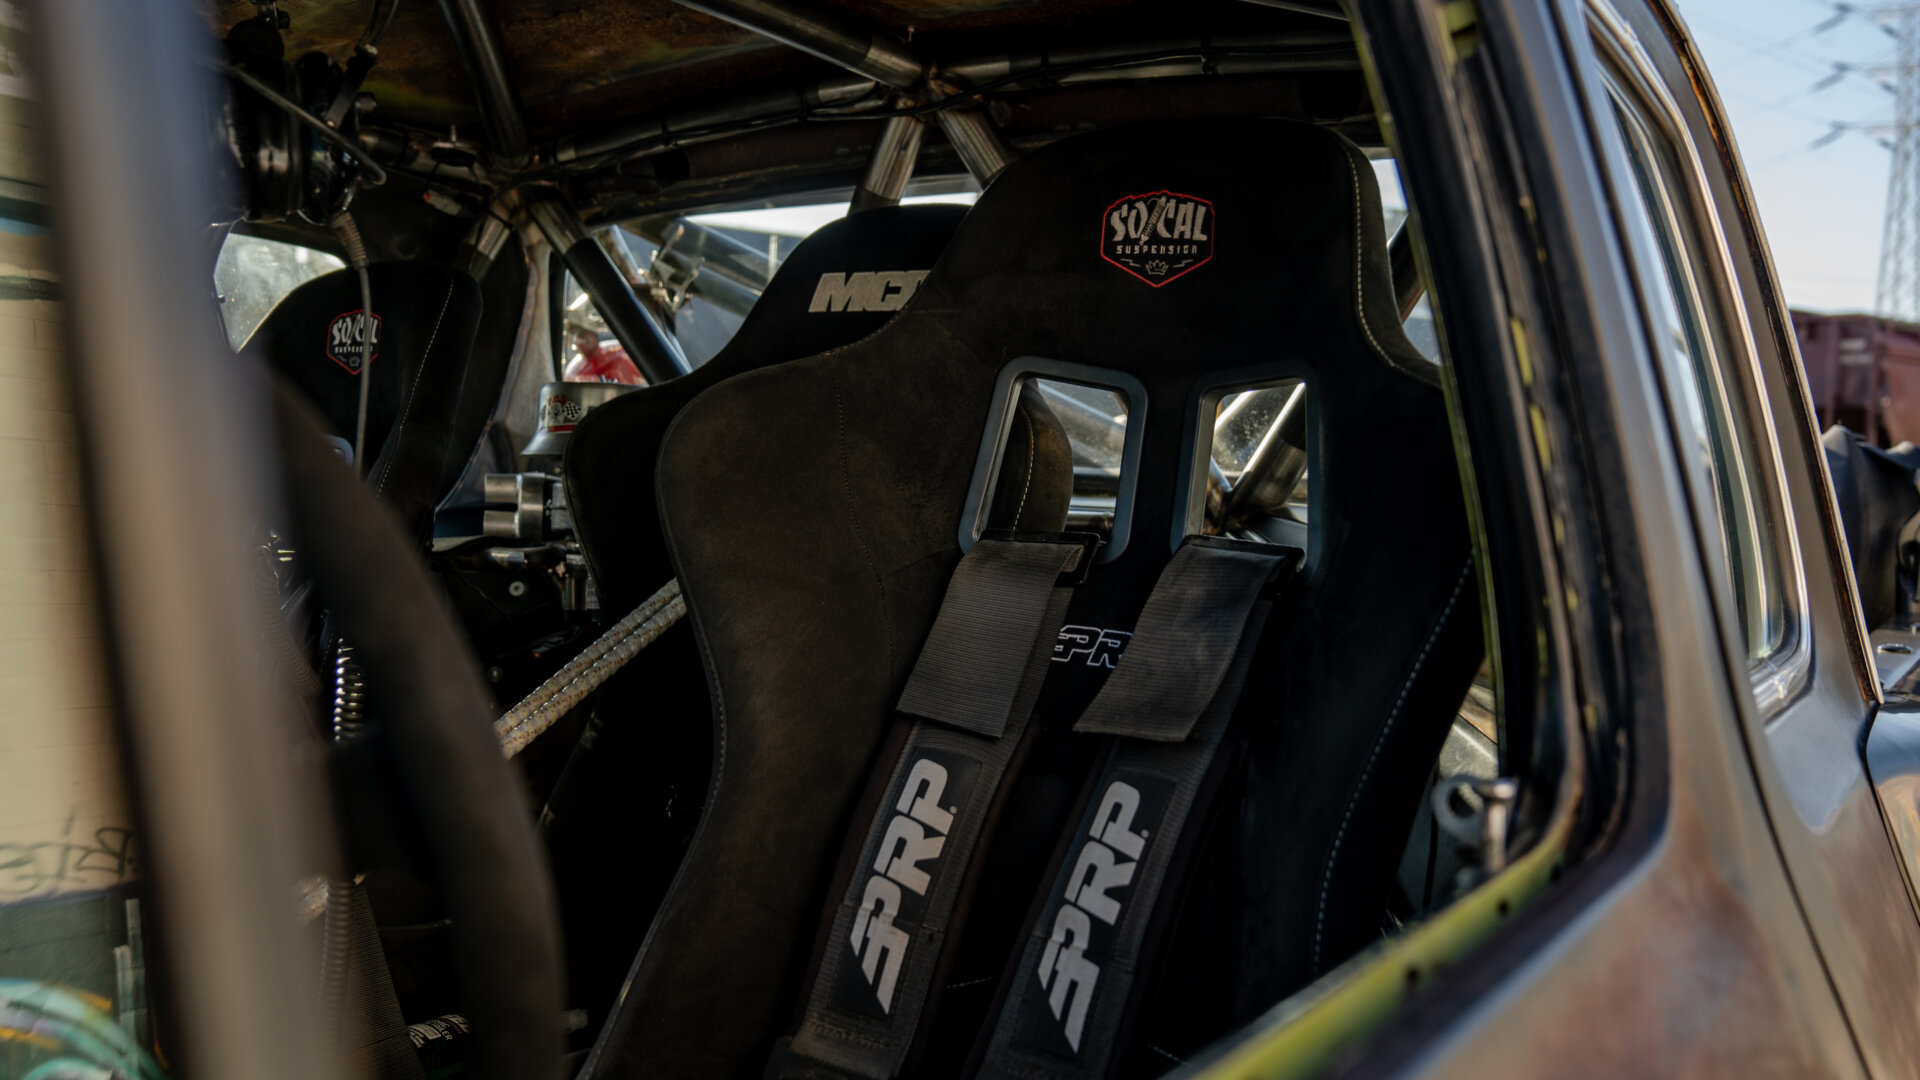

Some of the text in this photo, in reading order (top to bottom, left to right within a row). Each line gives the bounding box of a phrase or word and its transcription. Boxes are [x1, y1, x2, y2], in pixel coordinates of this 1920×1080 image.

[1116, 245, 1198, 255] SUSPENSION
[850, 758, 954, 1016] PRP
[1037, 780, 1147, 1054] PRP
